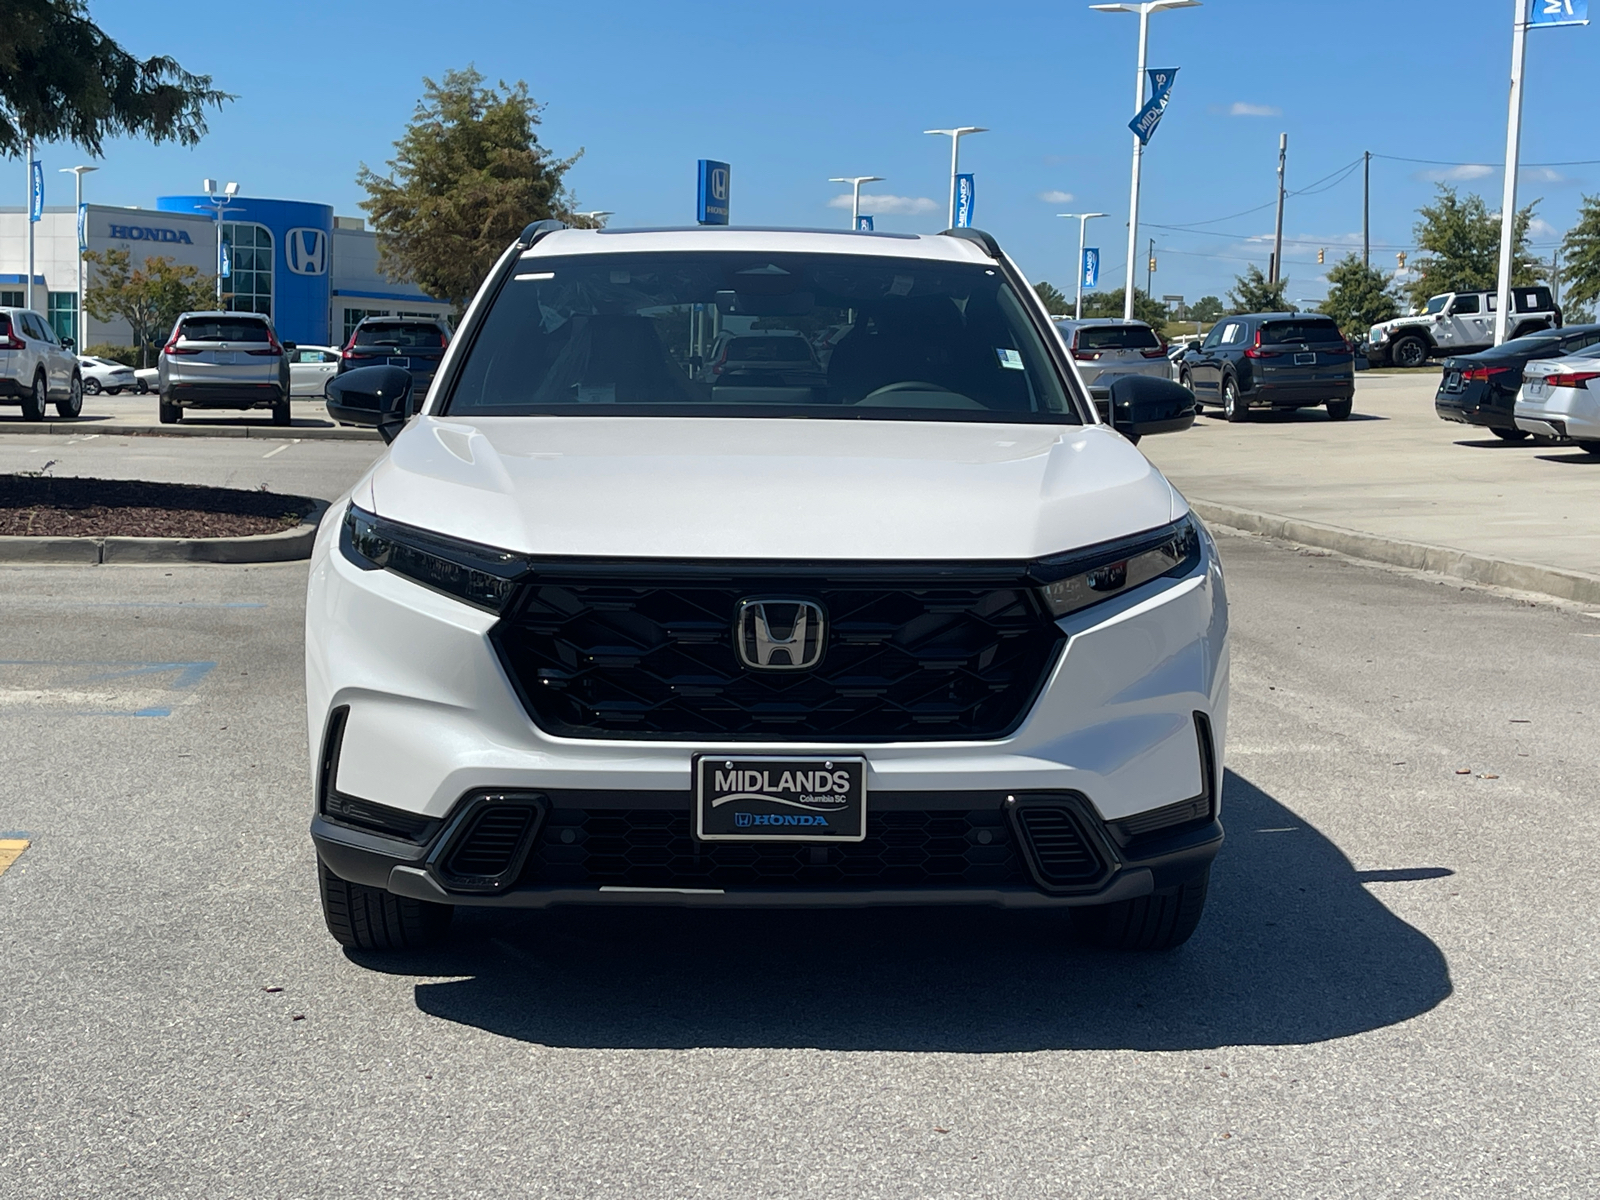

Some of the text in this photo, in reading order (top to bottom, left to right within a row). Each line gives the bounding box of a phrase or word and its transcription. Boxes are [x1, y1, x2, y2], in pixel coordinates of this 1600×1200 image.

[958, 178, 967, 228] MIDLANDS
[108, 223, 194, 245] HONDA
[714, 770, 850, 793] MIDLANDS
[799, 794, 847, 803] Columbia SC
[753, 814, 829, 826] HONDA
